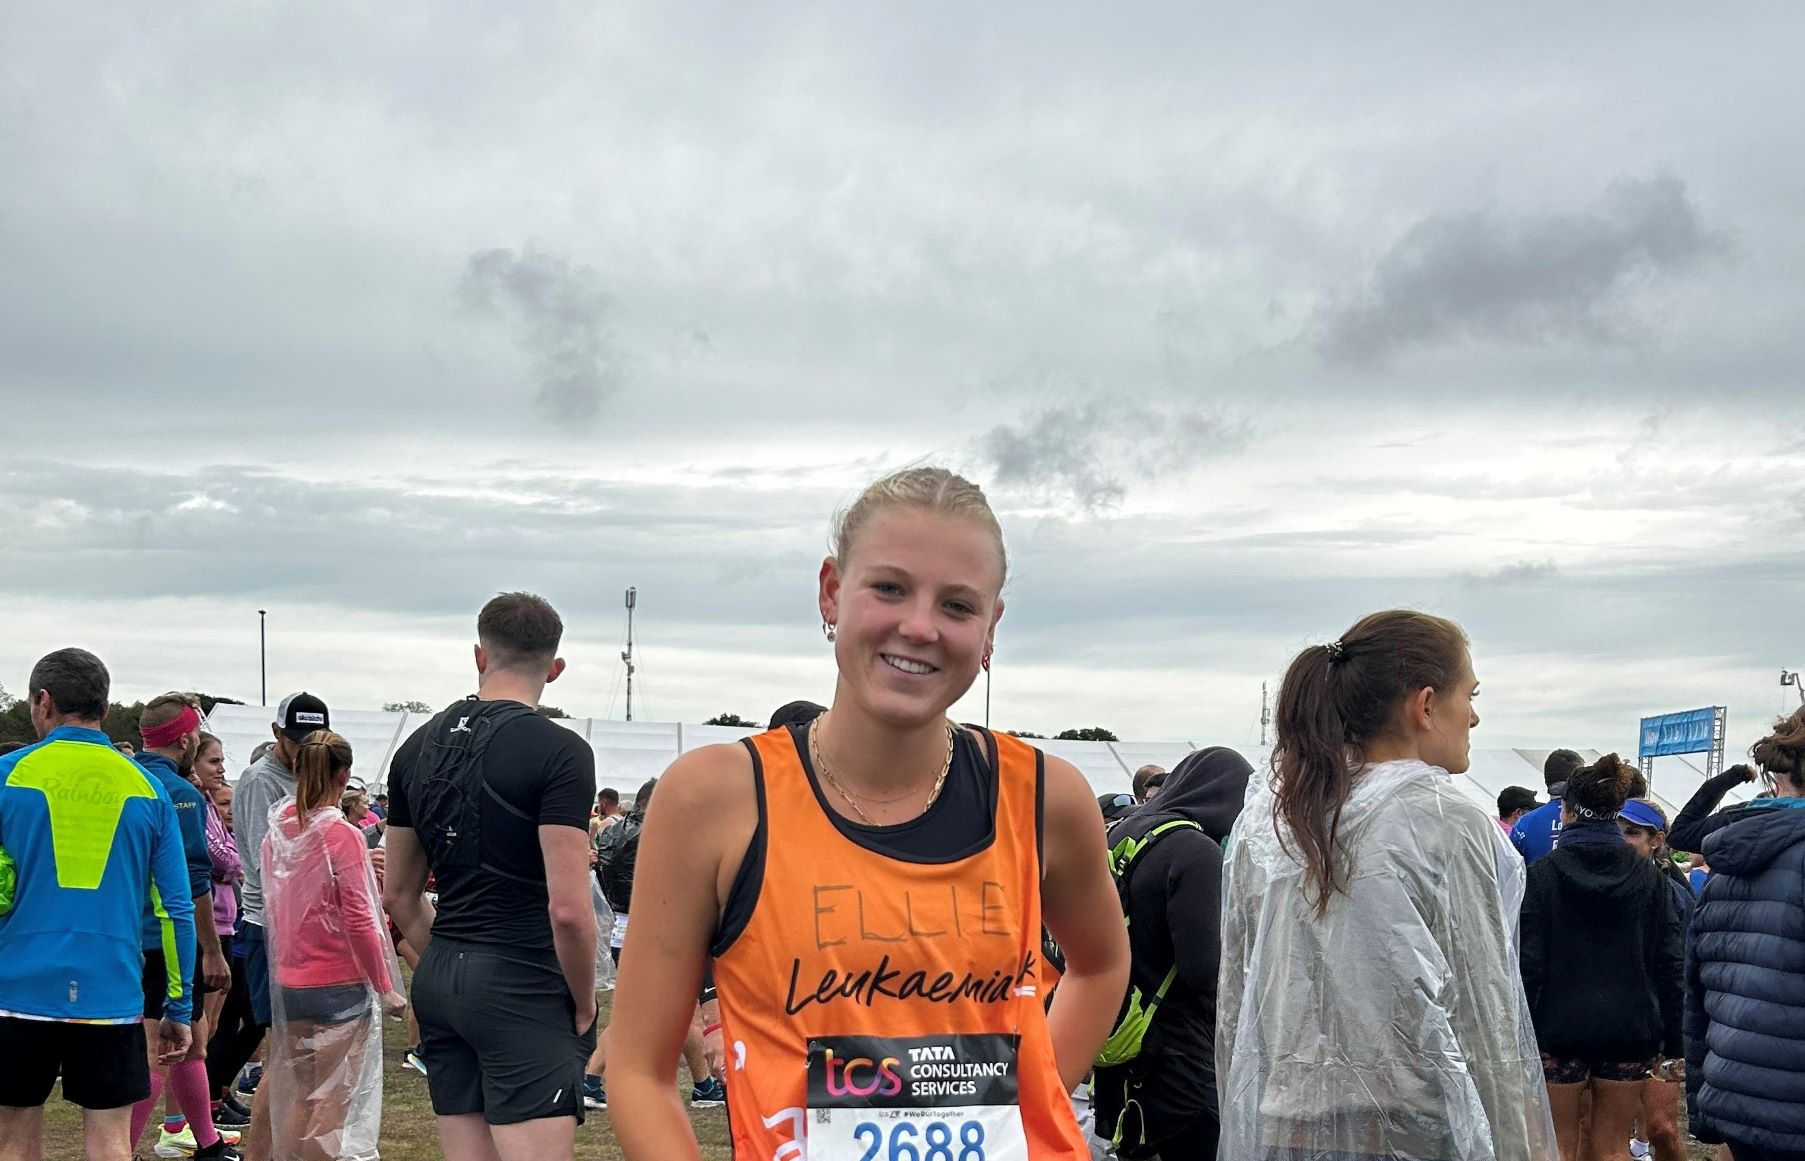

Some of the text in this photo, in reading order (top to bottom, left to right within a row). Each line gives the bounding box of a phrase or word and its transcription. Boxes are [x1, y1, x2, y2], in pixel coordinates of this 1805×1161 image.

[813, 881, 1011, 951] ELLIE
[785, 955, 1013, 1015] Leukaemia
[908, 1046, 955, 1062] TATA
[910, 1062, 1009, 1079] CONSULTANCY
[825, 1048, 902, 1097] tcs
[911, 1080, 977, 1096] SERVICES
